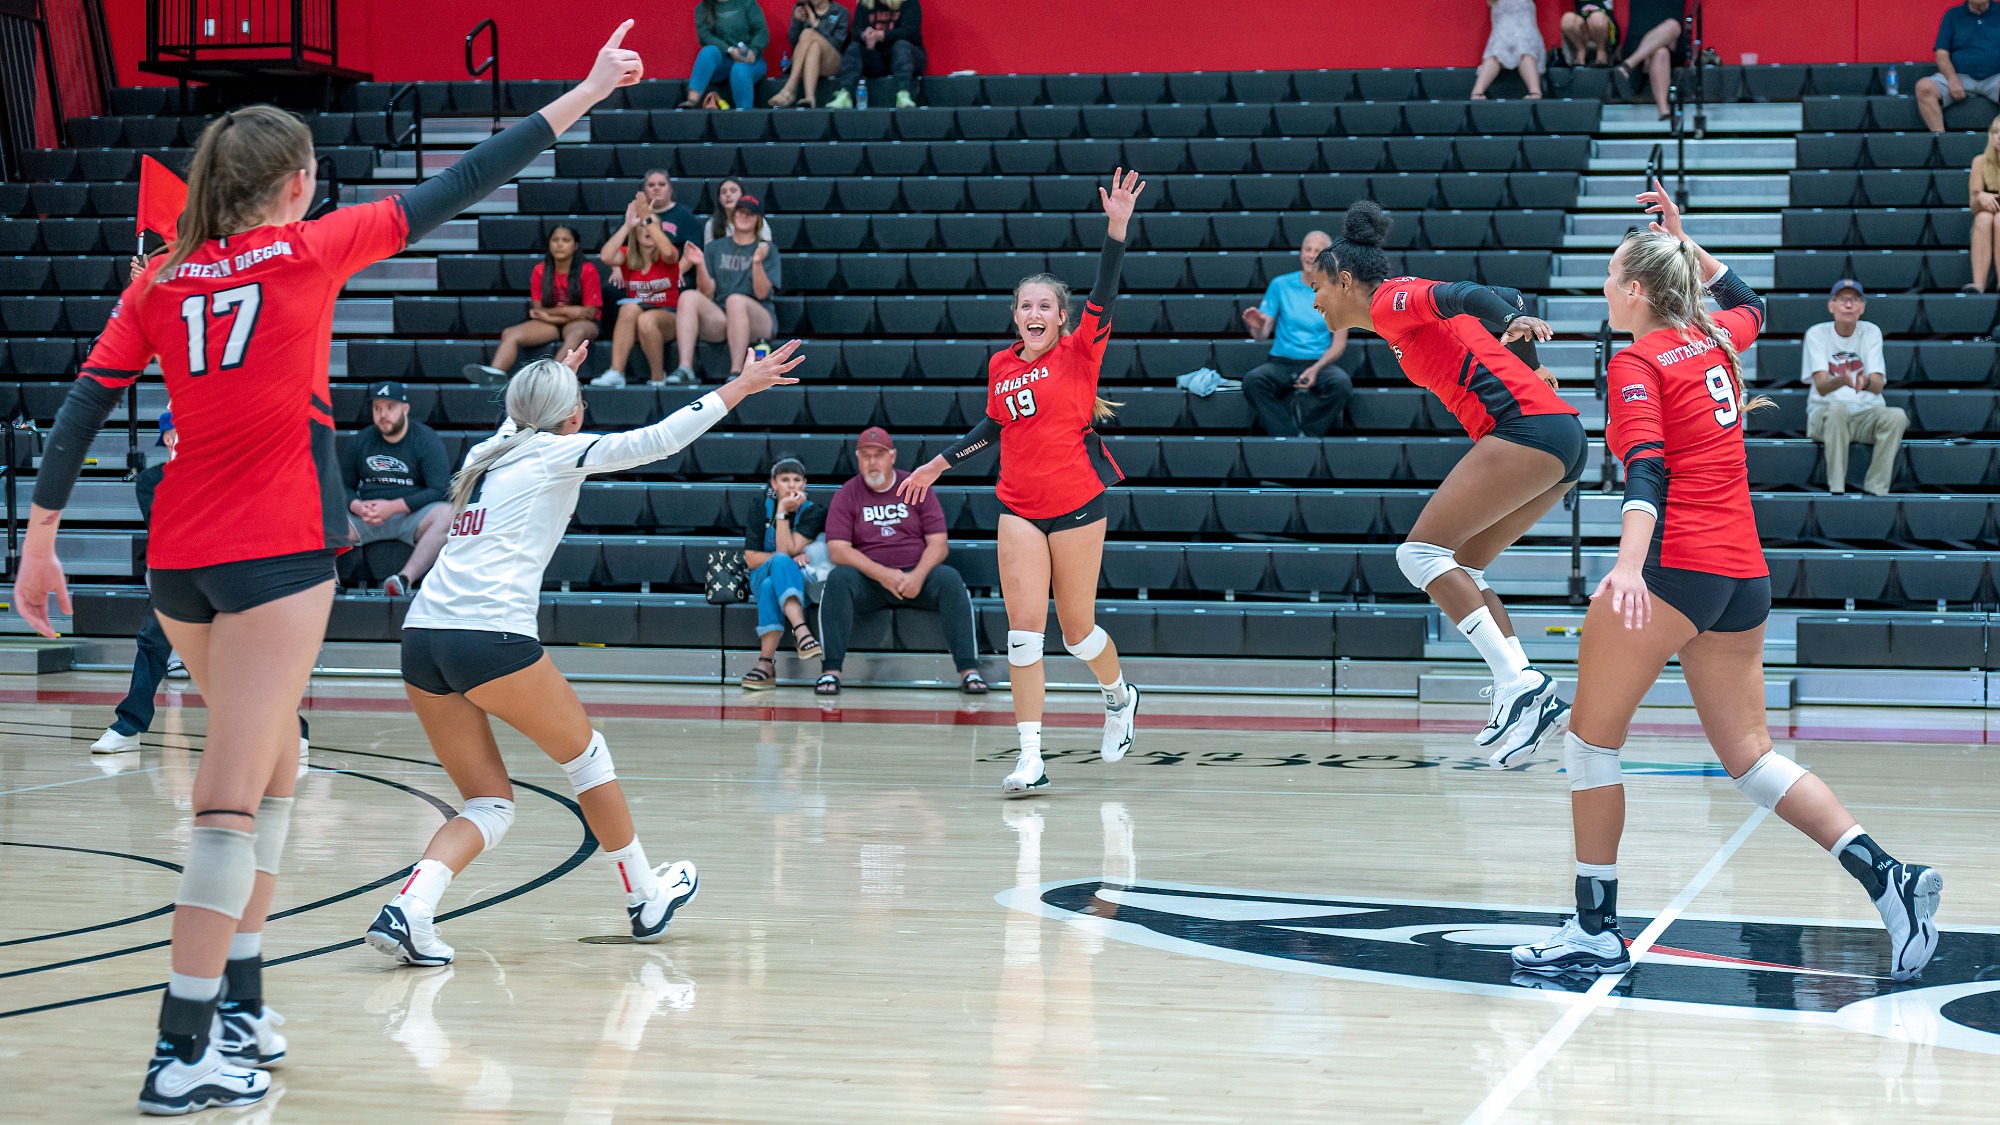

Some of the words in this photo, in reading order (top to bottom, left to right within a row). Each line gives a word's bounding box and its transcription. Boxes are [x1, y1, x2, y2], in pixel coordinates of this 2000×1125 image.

[154, 258, 232, 283] UTHERN
[234, 241, 293, 271] OREGON
[181, 281, 263, 377] 17
[1005, 387, 1038, 422] 19
[1704, 363, 1739, 429] 9
[954, 438, 989, 459] RAIDERBALL
[450, 507, 488, 537] SOU
[862, 502, 909, 522] BUCS
